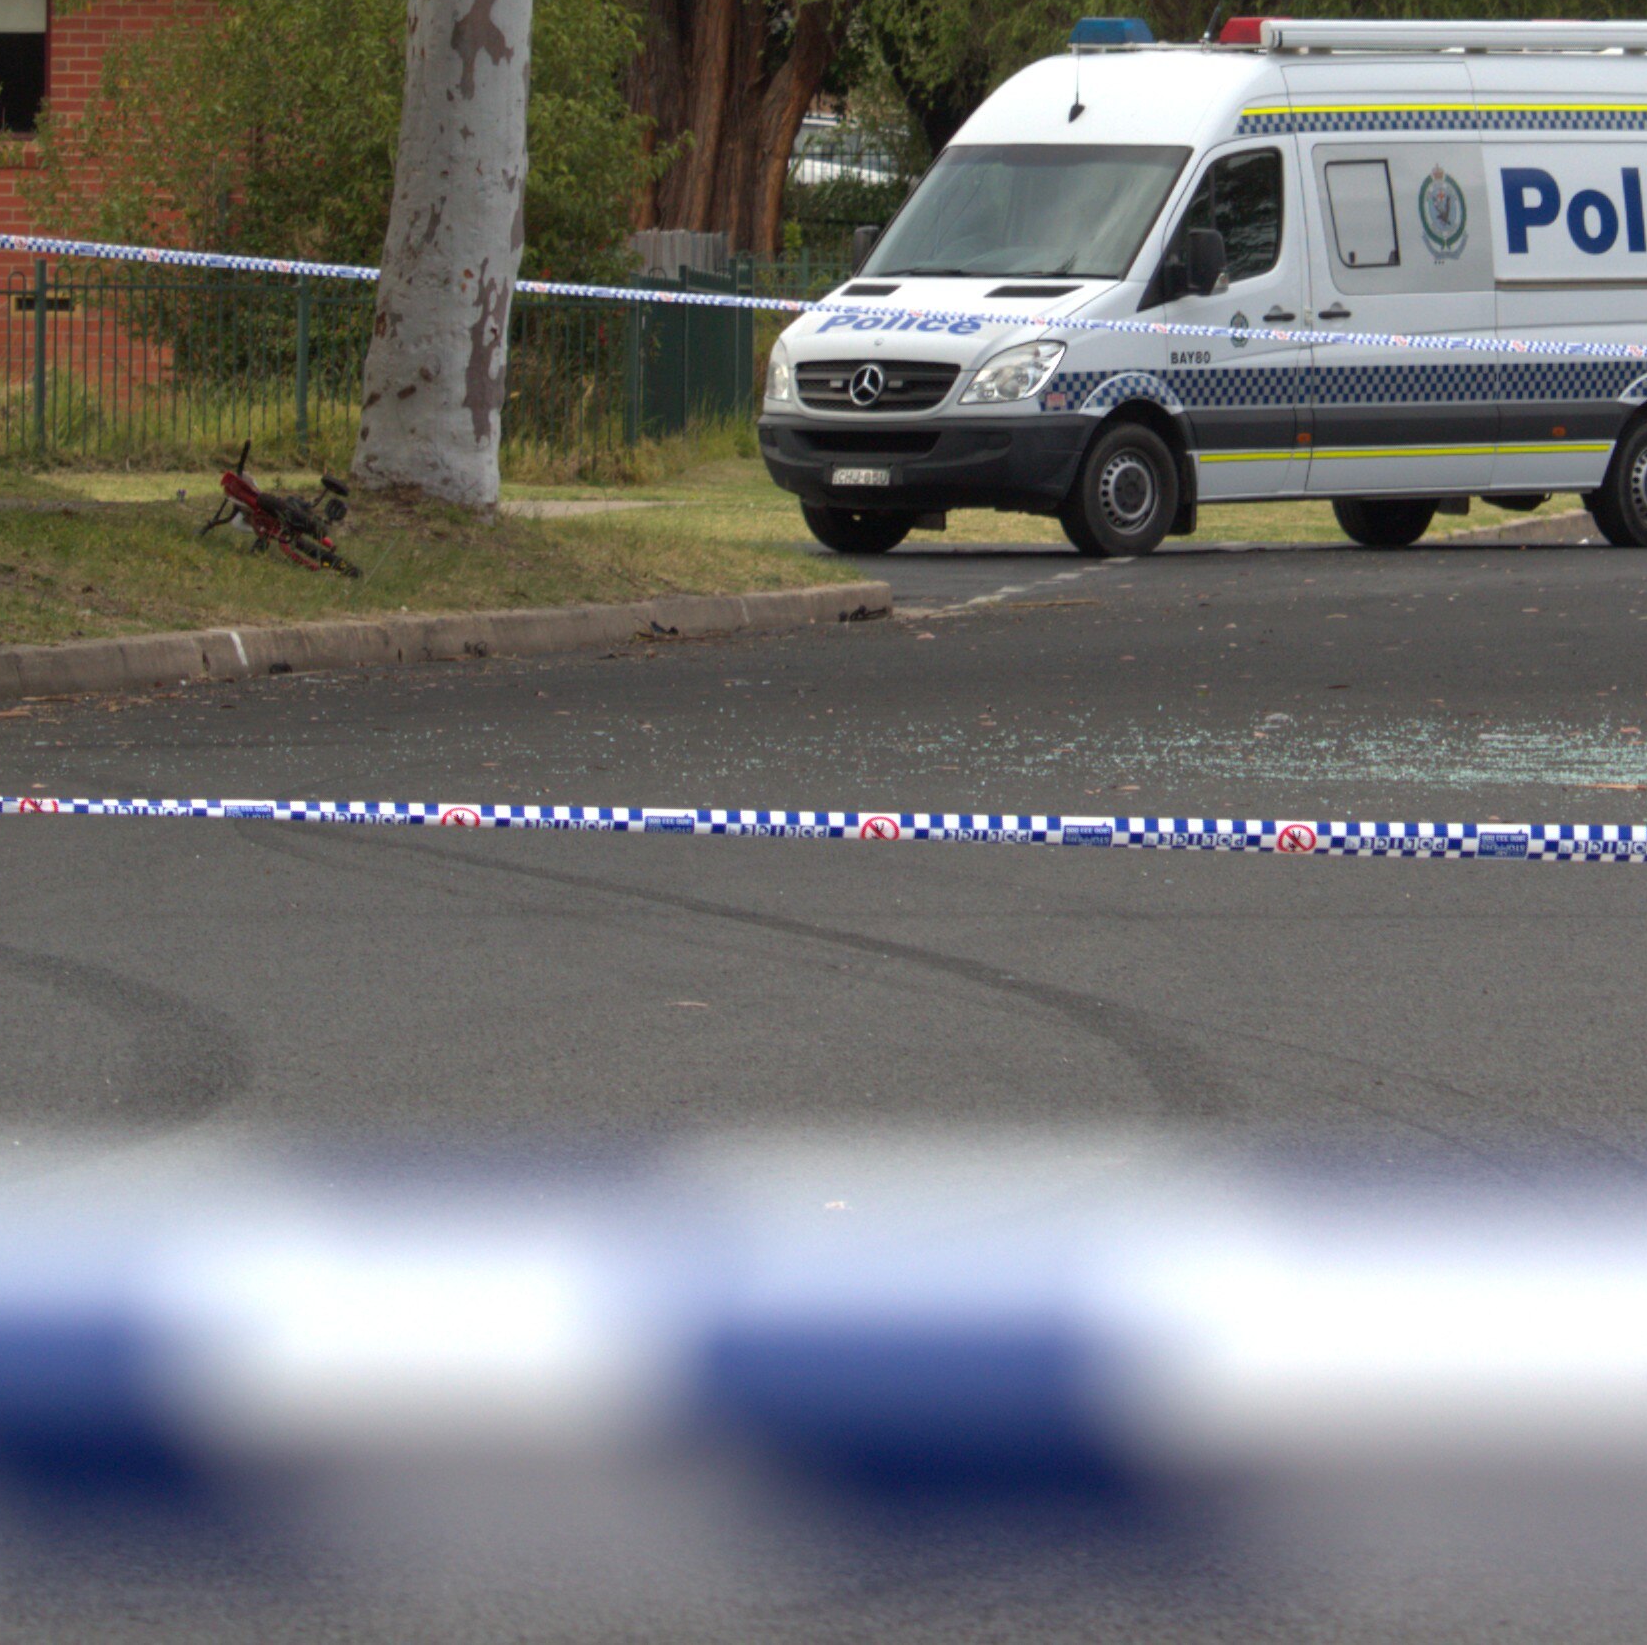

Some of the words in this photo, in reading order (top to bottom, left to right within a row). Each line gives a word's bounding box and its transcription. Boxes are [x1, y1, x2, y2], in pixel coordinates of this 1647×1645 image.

[815, 314, 982, 336] Police
[946, 828, 1031, 841] POLICE
[1161, 834, 1245, 847] POLICE
[1362, 837, 1446, 850] POLICE
